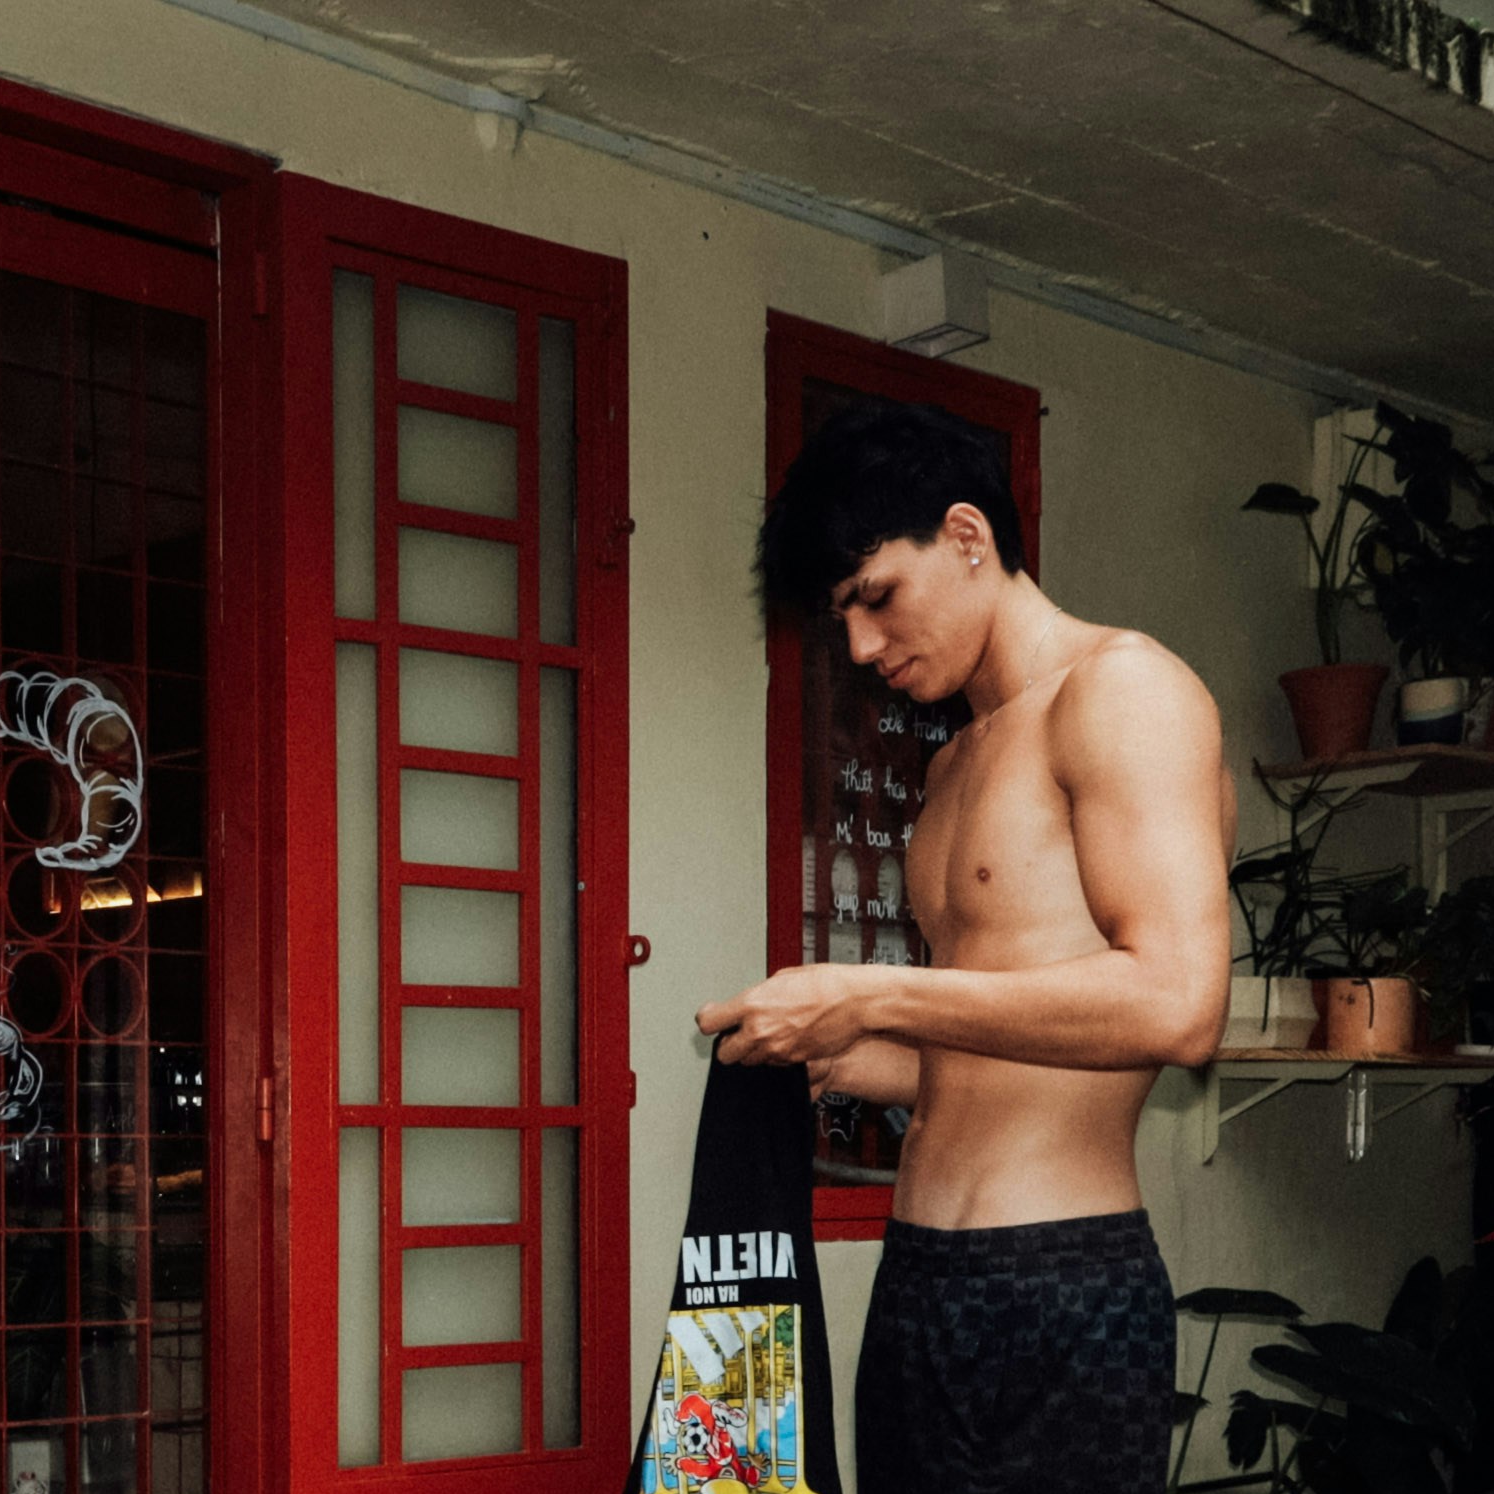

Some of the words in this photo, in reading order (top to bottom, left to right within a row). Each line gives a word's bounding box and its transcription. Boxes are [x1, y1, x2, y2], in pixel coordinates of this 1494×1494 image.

[682, 1230, 798, 1284] VIETN
[685, 1286, 716, 1306] NOI
[717, 1284, 739, 1303] HA
